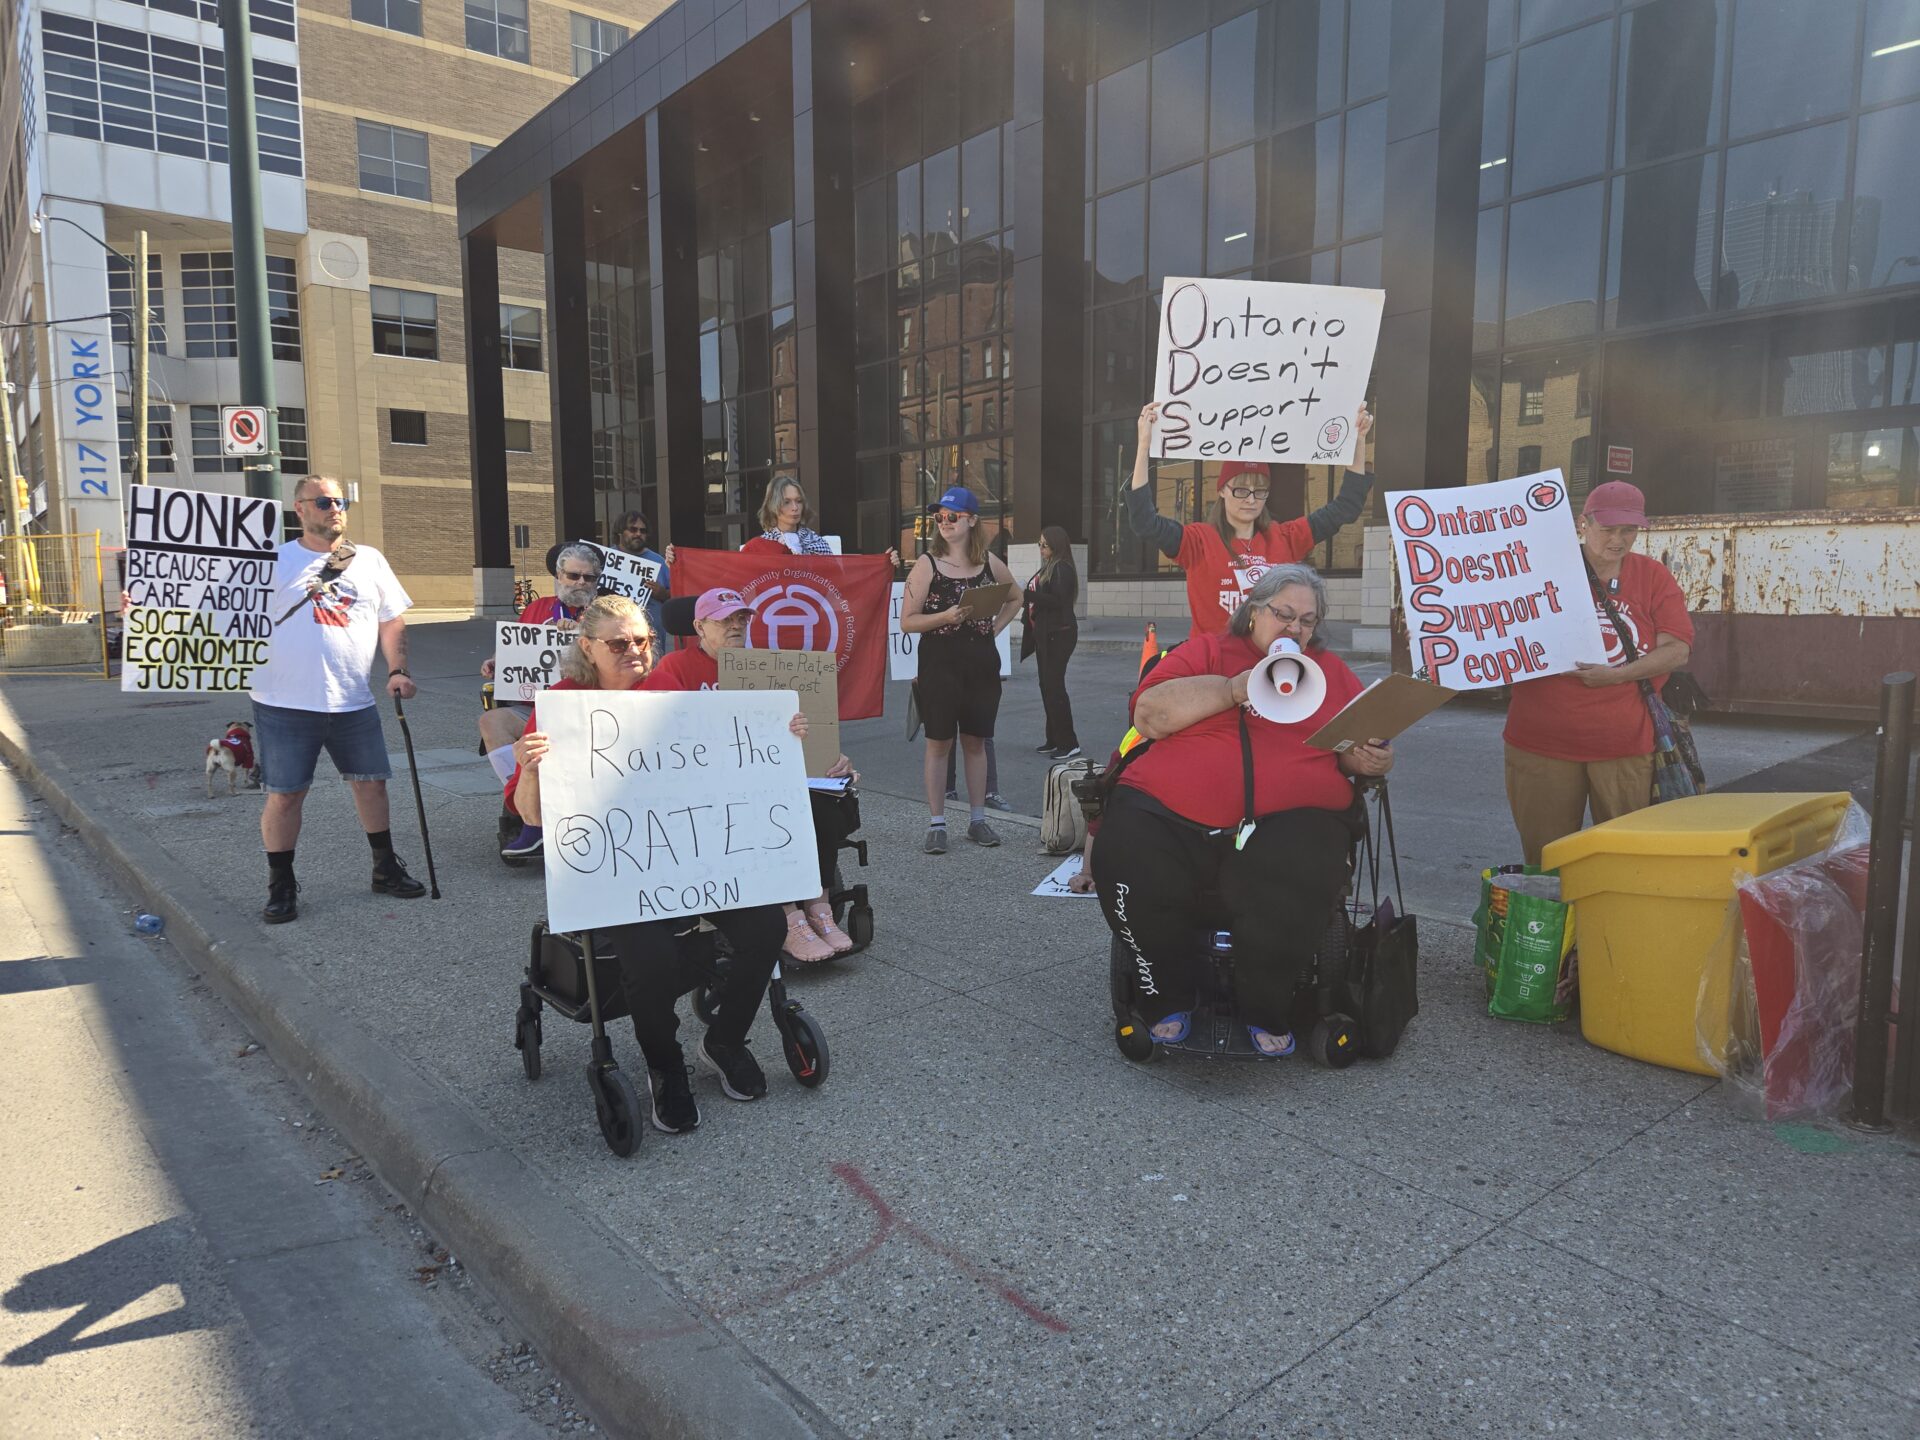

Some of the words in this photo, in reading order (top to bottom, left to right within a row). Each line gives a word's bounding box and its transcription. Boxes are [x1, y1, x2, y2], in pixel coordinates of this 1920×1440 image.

[1166, 283, 1346, 350] Ontario
[71, 338, 103, 426] YORK
[1169, 346, 1338, 396] Doesn't
[1161, 387, 1321, 433] Support
[1161, 425, 1291, 458] People
[1311, 448, 1343, 461] ACORN
[78, 443, 109, 495] 217
[130, 486, 276, 550] HONK!
[1395, 495, 1528, 537] Ontario
[129, 550, 220, 582] BECAUSE
[226, 559, 274, 585] YOU
[630, 560, 655, 579] THE
[1404, 540, 1531, 585] Doesn't
[128, 579, 191, 608] CARE
[200, 586, 274, 612] ABOUT
[597, 574, 633, 598] ATES
[129, 609, 220, 637] SOCIAL
[225, 613, 273, 639] AND
[740, 570, 780, 598] ommunity
[783, 568, 841, 600] Organizations
[839, 600, 849, 613] for
[845, 616, 856, 652] Reform
[1410, 580, 1562, 641] Support
[126, 637, 269, 665] ECONOMIC
[501, 626, 541, 646] STOP
[890, 632, 912, 655] TO
[137, 665, 253, 691] JUSTICE
[502, 666, 553, 684] START
[724, 652, 767, 671] Raise
[770, 652, 794, 671] The
[797, 653, 836, 674] Rates
[1419, 636, 1549, 686] People
[738, 677, 755, 690] To
[766, 675, 787, 690] The
[789, 675, 821, 693] Cost
[590, 710, 709, 778] Raise
[729, 716, 781, 768] the
[605, 802, 792, 877] RATES
[640, 877, 740, 916] ACORN
[1114, 882, 1129, 922] day
[1120, 926, 1142, 952] all
[1136, 953, 1159, 995] sleep
